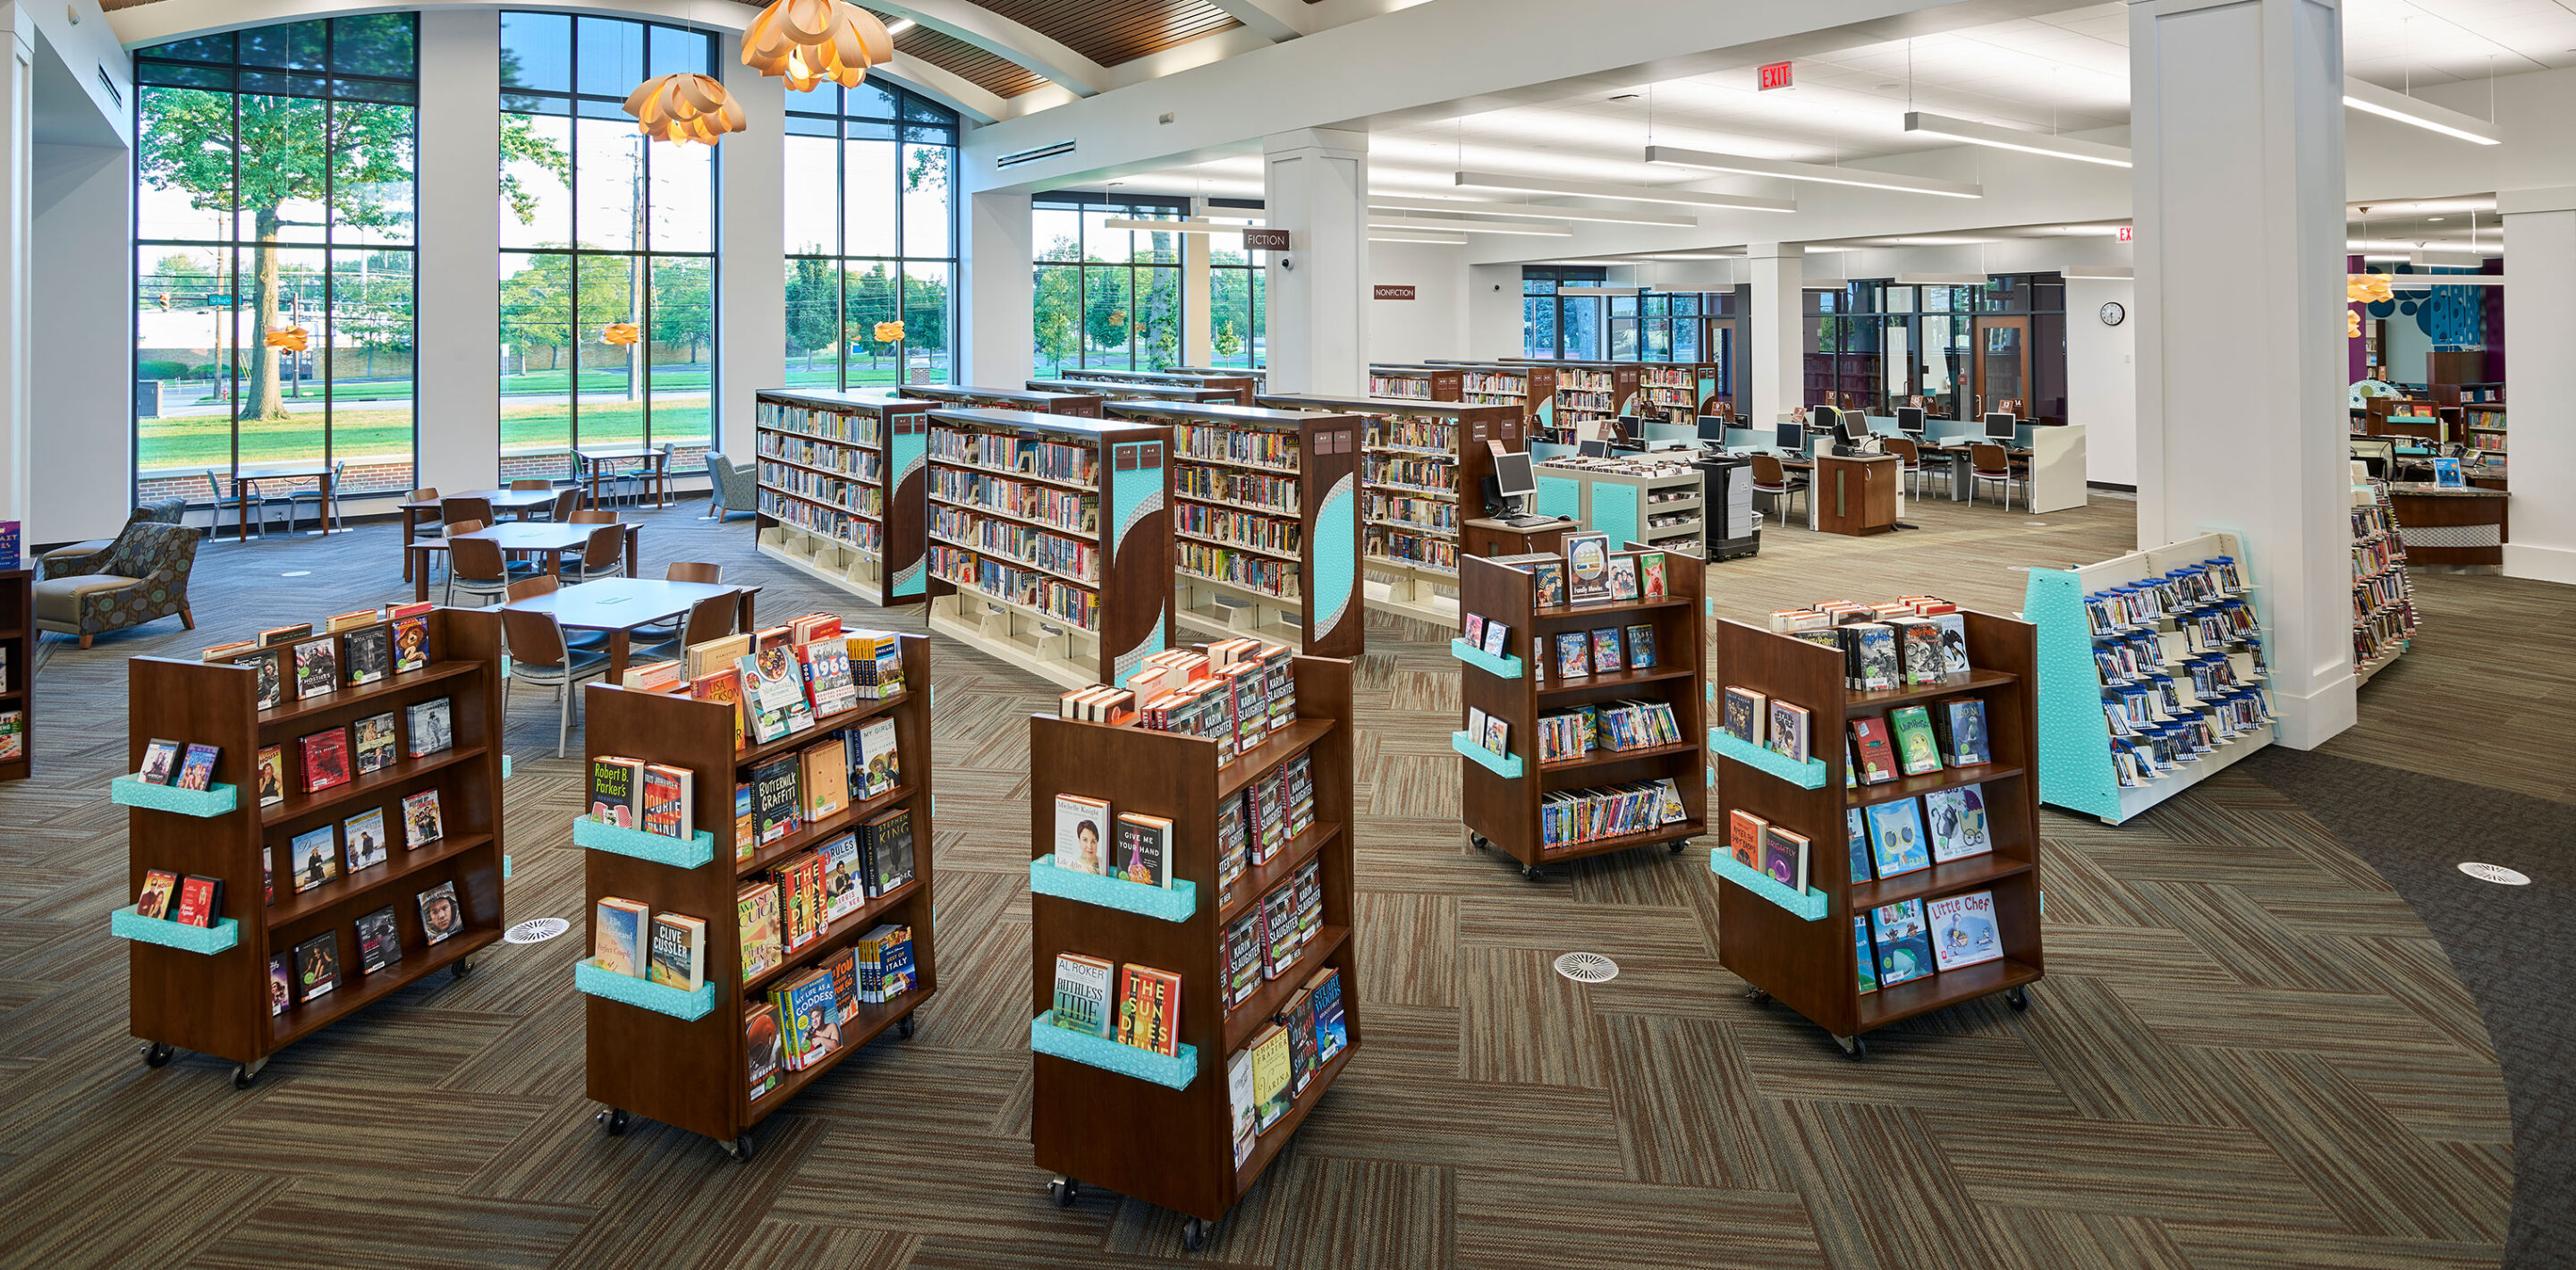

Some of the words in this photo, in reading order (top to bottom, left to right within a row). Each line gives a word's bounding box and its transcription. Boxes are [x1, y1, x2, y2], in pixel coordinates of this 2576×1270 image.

[1762, 65, 1789, 88] EXIT
[1247, 234, 1285, 246] FICTION
[2120, 227, 2132, 241] EX
[1376, 288, 1414, 297] NONFICTION
[1563, 635, 1584, 643] STORKS
[1864, 635, 1877, 645] Harry
[1877, 633, 1890, 643] Potter
[1910, 629, 1922, 639] Harry
[1923, 627, 1938, 637] Potter
[876, 646, 894, 655] ENGLAND
[801, 663, 809, 682] 1968
[811, 654, 850, 678] 1968
[303, 673, 331, 684] HOSTILES
[709, 680, 725, 694] LISA
[1269, 674, 1284, 690] KARIN
[1241, 692, 1257, 708] KARIN
[1267, 682, 1294, 702] SLAUGHTER
[1205, 712, 1222, 729] KARIN
[1238, 699, 1266, 722] SLAUGHTER
[1775, 710, 1793, 721] STAR
[863, 731, 873, 739] MY
[874, 723, 894, 735] GIRLS
[1203, 719, 1233, 739] SLAUGHTER
[259, 751, 279, 765] HOUSE
[595, 762, 621, 781] Robert
[622, 767, 629, 783] B.
[596, 778, 626, 797] Parker's
[758, 772, 797, 797] BUTTERMILK
[1292, 777, 1305, 792] KARIN
[645, 792, 681, 818] DOUBLE
[761, 787, 796, 812] GRAFFITI
[1290, 783, 1312, 807] SLAUGHTER
[1057, 800, 1080, 812] Michelle
[1080, 807, 1099, 817] Knight
[1261, 806, 1283, 830] SLAUGHTER
[647, 813, 676, 836] BLIND
[878, 813, 908, 832] STEPHEN
[879, 823, 909, 843] KING
[1124, 831, 1140, 842] GIVE
[1143, 836, 1153, 844] ME
[825, 852, 832, 866] 9
[831, 840, 854, 858] RULES
[1119, 841, 1137, 851] YOUR
[1139, 846, 1159, 857] HAND
[1767, 838, 1796, 857] BRIGHTLY
[794, 863, 819, 881] THE
[1056, 856, 1069, 866] Life
[1071, 859, 1082, 869] After
[795, 879, 820, 902] SUN
[1299, 884, 1313, 901] KARIN
[738, 891, 777, 913] AMANDA
[1297, 888, 1320, 915] SLAUGHTER
[1965, 896, 1990, 911] Chef
[739, 902, 778, 927] QUICK
[1270, 910, 1287, 928] KARIN
[1882, 900, 1915, 924] DUDE!
[791, 909, 827, 938] SHINE
[1269, 916, 1298, 944] SLAUGHTER
[659, 926, 682, 943] CLIVE
[613, 948, 631, 959] Couple
[653, 936, 688, 959] CUSSLER
[1233, 938, 1250, 958] KARIN
[835, 956, 853, 978] YOU
[886, 954, 897, 962] BEST
[886, 957, 908, 972] ITALY
[1231, 944, 1260, 973] SLAUGHTER
[1058, 959, 1071, 971] AL
[1072, 964, 1105, 980] ROKER
[796, 996, 805, 1005] MY
[805, 990, 818, 1000] LIFE
[818, 986, 826, 995] AS
[1056, 978, 1103, 1001] RUTHLESS
[1130, 977, 1165, 1000] THE
[1314, 974, 1340, 1001] STUART
[796, 991, 834, 1016] GODDESS
[1058, 991, 1099, 1025] TIDE
[1316, 986, 1341, 1012] WOODS
[1128, 997, 1163, 1022] SUN
[1118, 1035, 1168, 1057] SHINE
[1256, 1032, 1287, 1056] CHARLES
[1257, 1040, 1287, 1064] FRAZIER
[1258, 1068, 1290, 1099] VARINA
